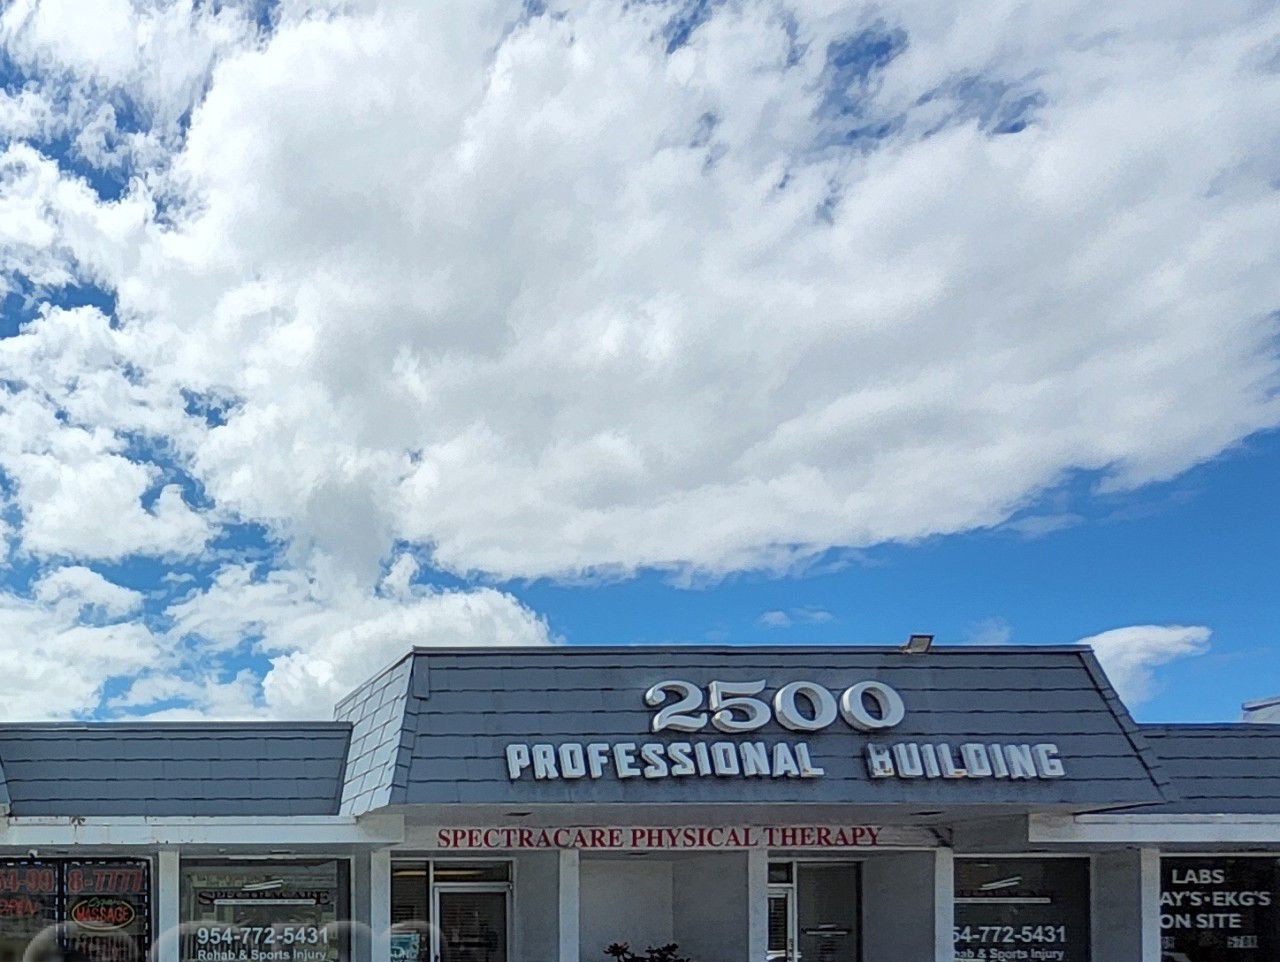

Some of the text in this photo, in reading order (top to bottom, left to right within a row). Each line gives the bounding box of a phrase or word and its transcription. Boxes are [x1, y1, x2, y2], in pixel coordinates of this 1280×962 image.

[645, 679, 906, 733] 2500
[506, 742, 1066, 779] PROFESSIONAL BUILDING
[437, 826, 884, 848] SPECTRACARE PHYSICAL THERAPY
[1171, 869, 1225, 884] LABS
[75, 905, 130, 923] MASSAGE
[1160, 913, 1242, 928] ON SITE
[197, 926, 329, 944] 954-772-5431
[198, 949, 327, 962] Rehab & Sports Injury
[977, 948, 987, 959] &
[989, 948, 1028, 961] Sports
[1030, 948, 1065, 960] Injury
